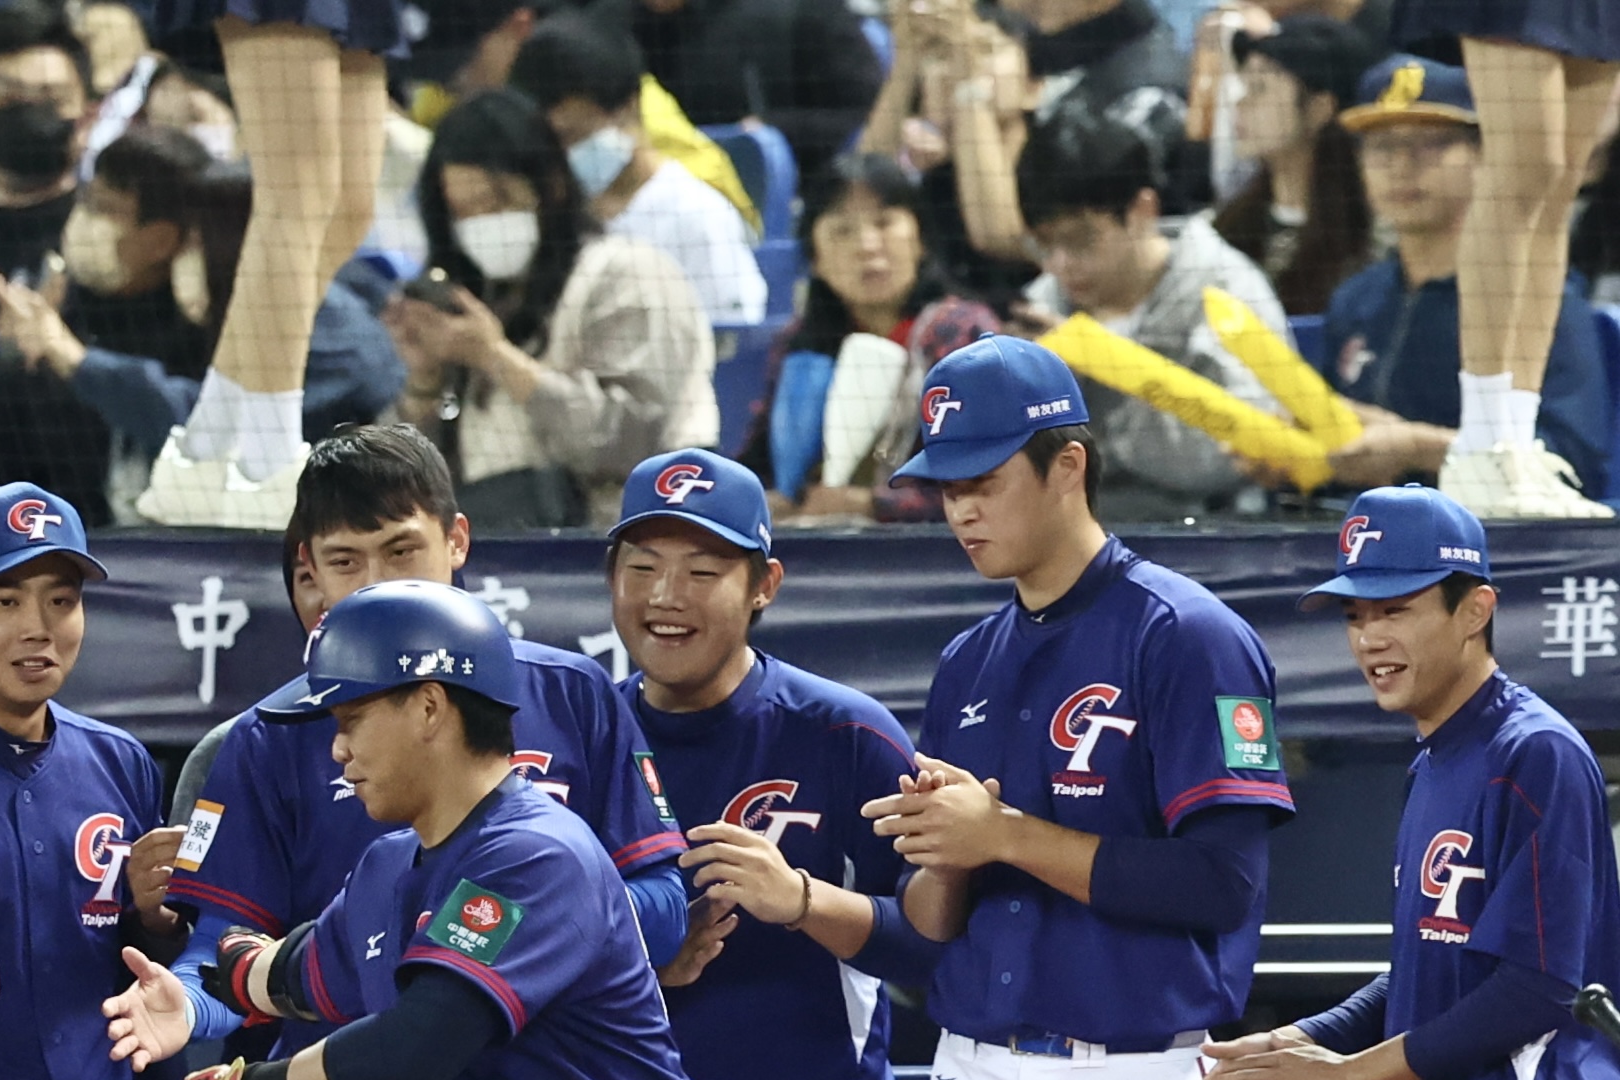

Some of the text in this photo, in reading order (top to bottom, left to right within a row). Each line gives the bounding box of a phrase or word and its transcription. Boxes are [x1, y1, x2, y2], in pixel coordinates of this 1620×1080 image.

[1051, 783, 1105, 798] Taipei
[81, 913, 120, 927] Taipei
[448, 934, 477, 953] CTBC
[1418, 928, 1470, 944] Taipei
